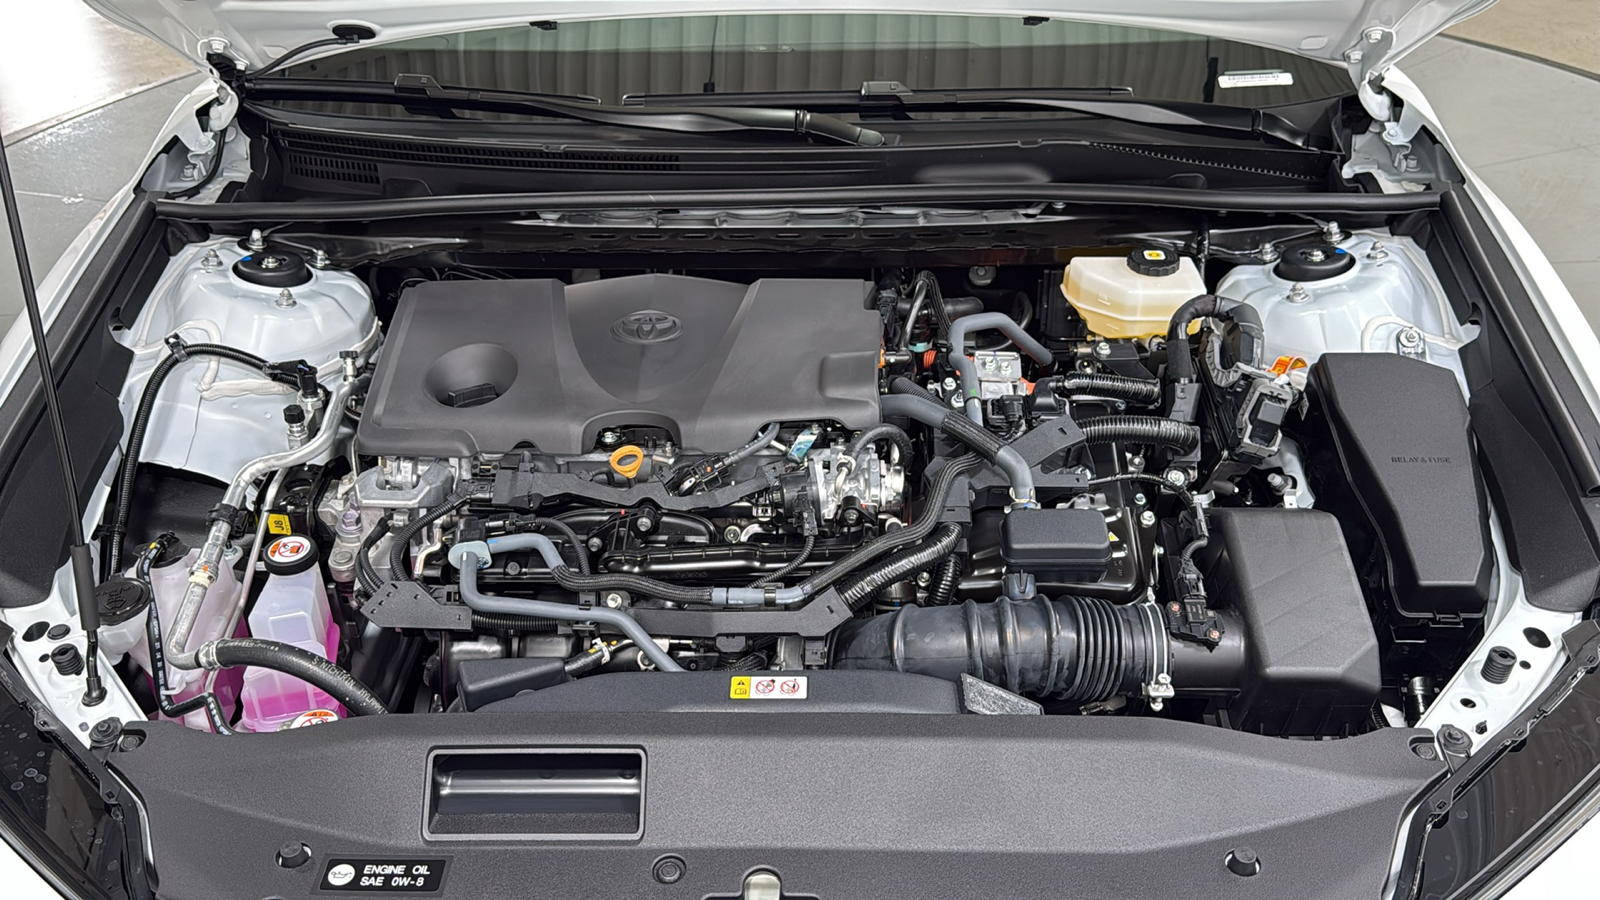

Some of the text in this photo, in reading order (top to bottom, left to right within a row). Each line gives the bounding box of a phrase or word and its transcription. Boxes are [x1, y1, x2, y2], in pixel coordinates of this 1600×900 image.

[1391, 456, 1419, 464] RELAY
[1428, 456, 1451, 464] FUSE
[273, 520, 285, 531] J8
[320, 661, 356, 688] NICHIRIN
[363, 864, 431, 875] ENGINE OIL
[360, 876, 425, 887] SAE 0W-8
